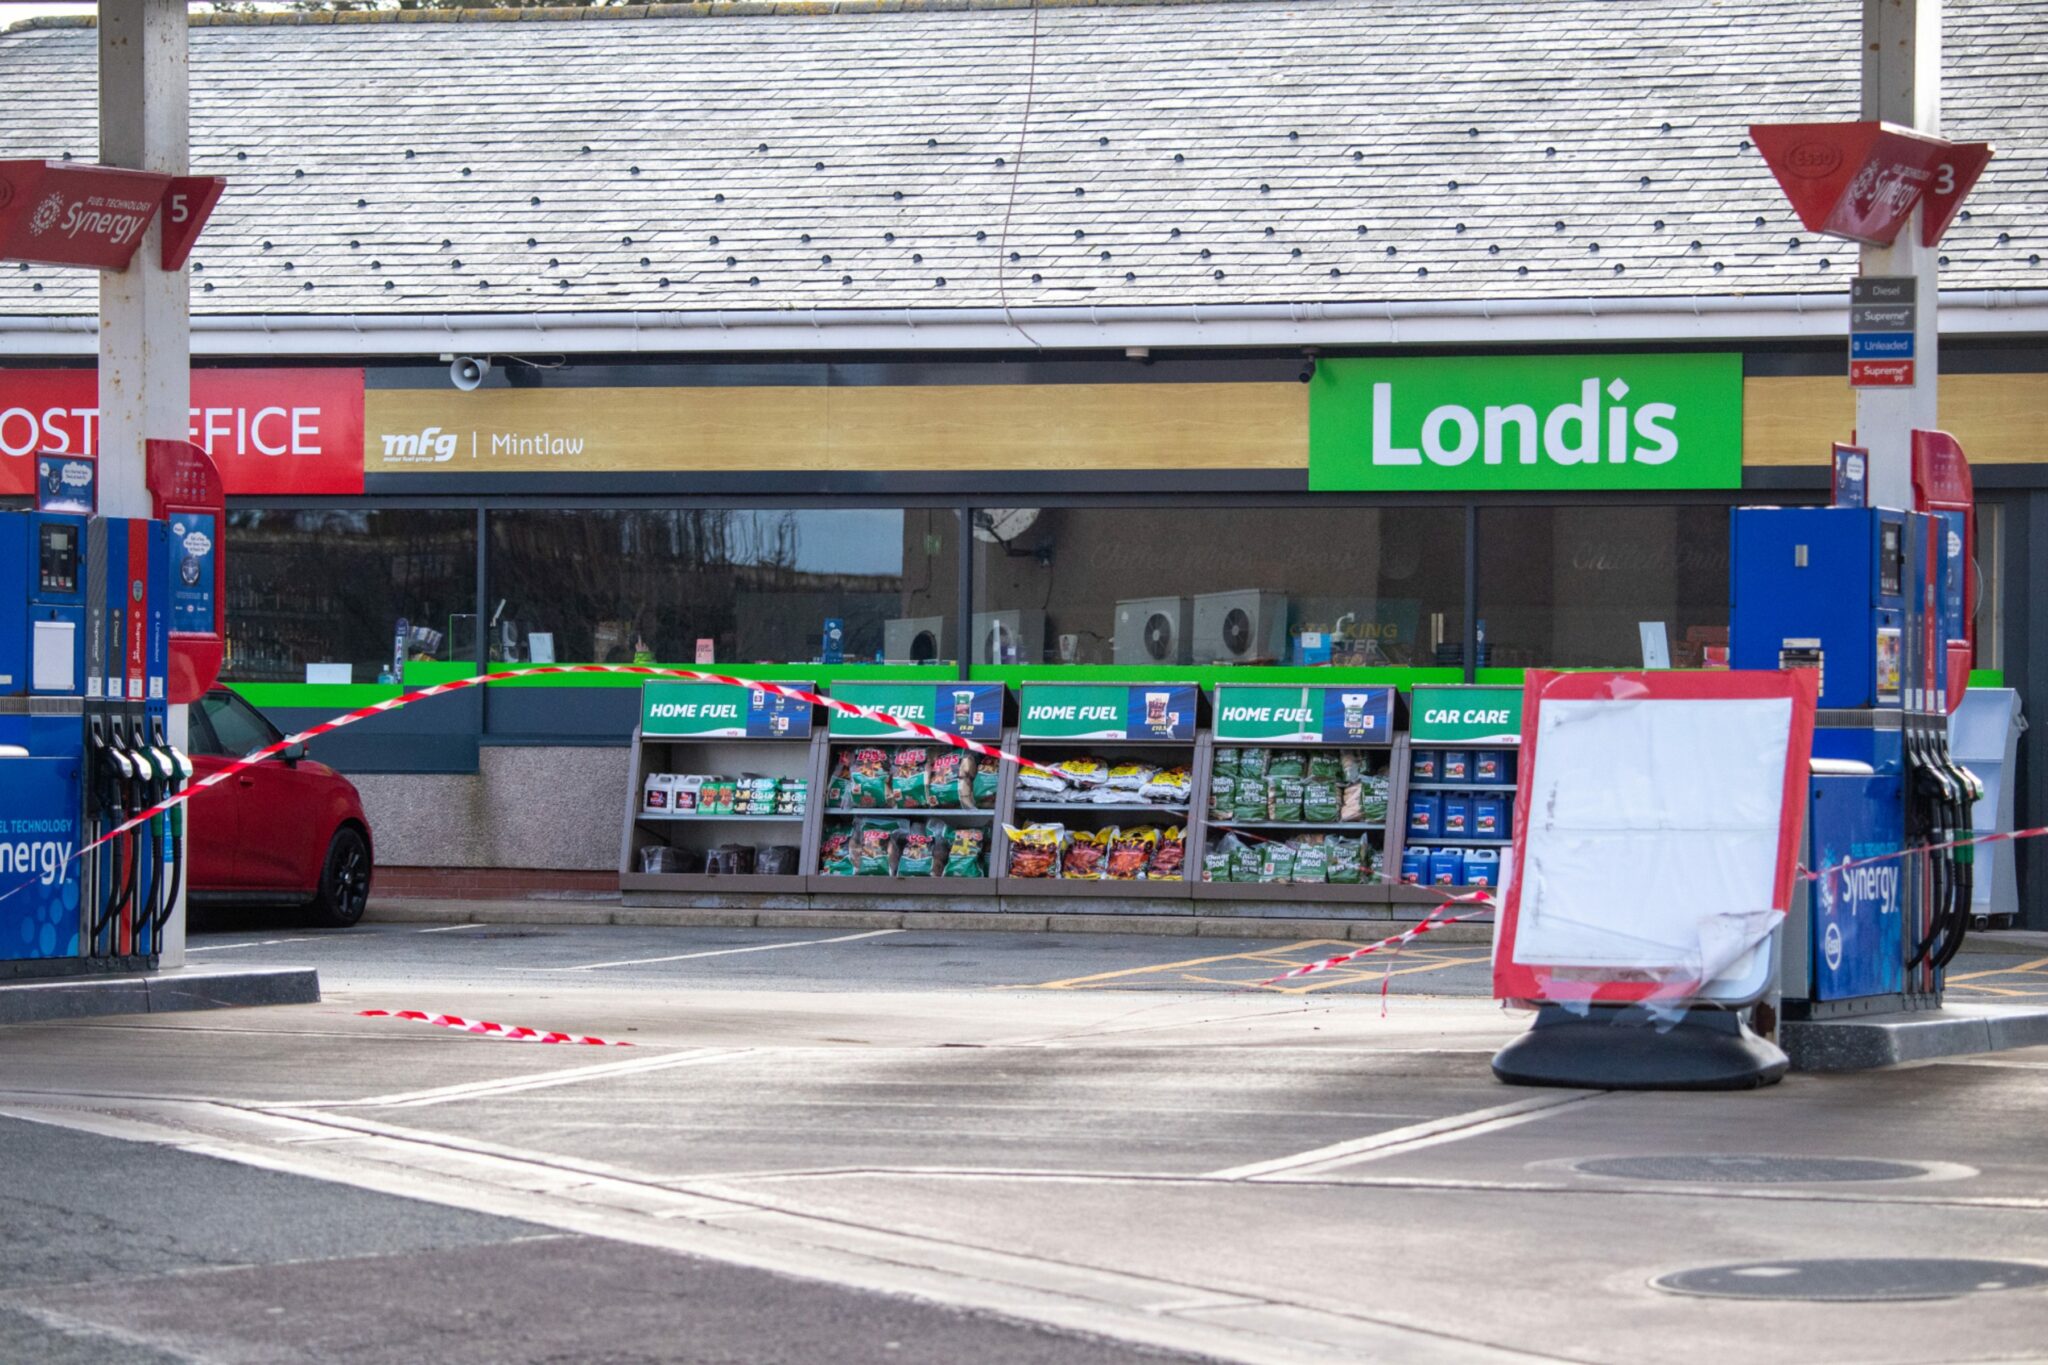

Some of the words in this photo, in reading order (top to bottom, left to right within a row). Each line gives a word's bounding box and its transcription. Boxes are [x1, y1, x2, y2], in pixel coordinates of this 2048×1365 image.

[1934, 163, 1955, 195] 3
[86, 196, 104, 207] FUEL
[105, 199, 153, 212] TECHNOLOGY
[171, 194, 189, 223] 5
[60, 201, 145, 245] Synergy
[1872, 286, 1900, 296] Diesel
[1864, 341, 1909, 352] Unleaded
[1372, 376, 1679, 467] Londis
[381, 427, 458, 463] mfg
[492, 433, 584, 456] Mintlaw
[650, 703, 697, 718] HOME
[700, 703, 738, 718] FUEL
[1027, 705, 1076, 720] HOME
[1078, 706, 1118, 720] FUEL
[1222, 707, 1271, 722] HOME
[1273, 707, 1314, 722] FUEL
[1424, 709, 1460, 723] CAR
[1463, 709, 1510, 724] CARE
[11, 819, 73, 833] TECHNOLOGY
[1842, 855, 1899, 916] Synergy
